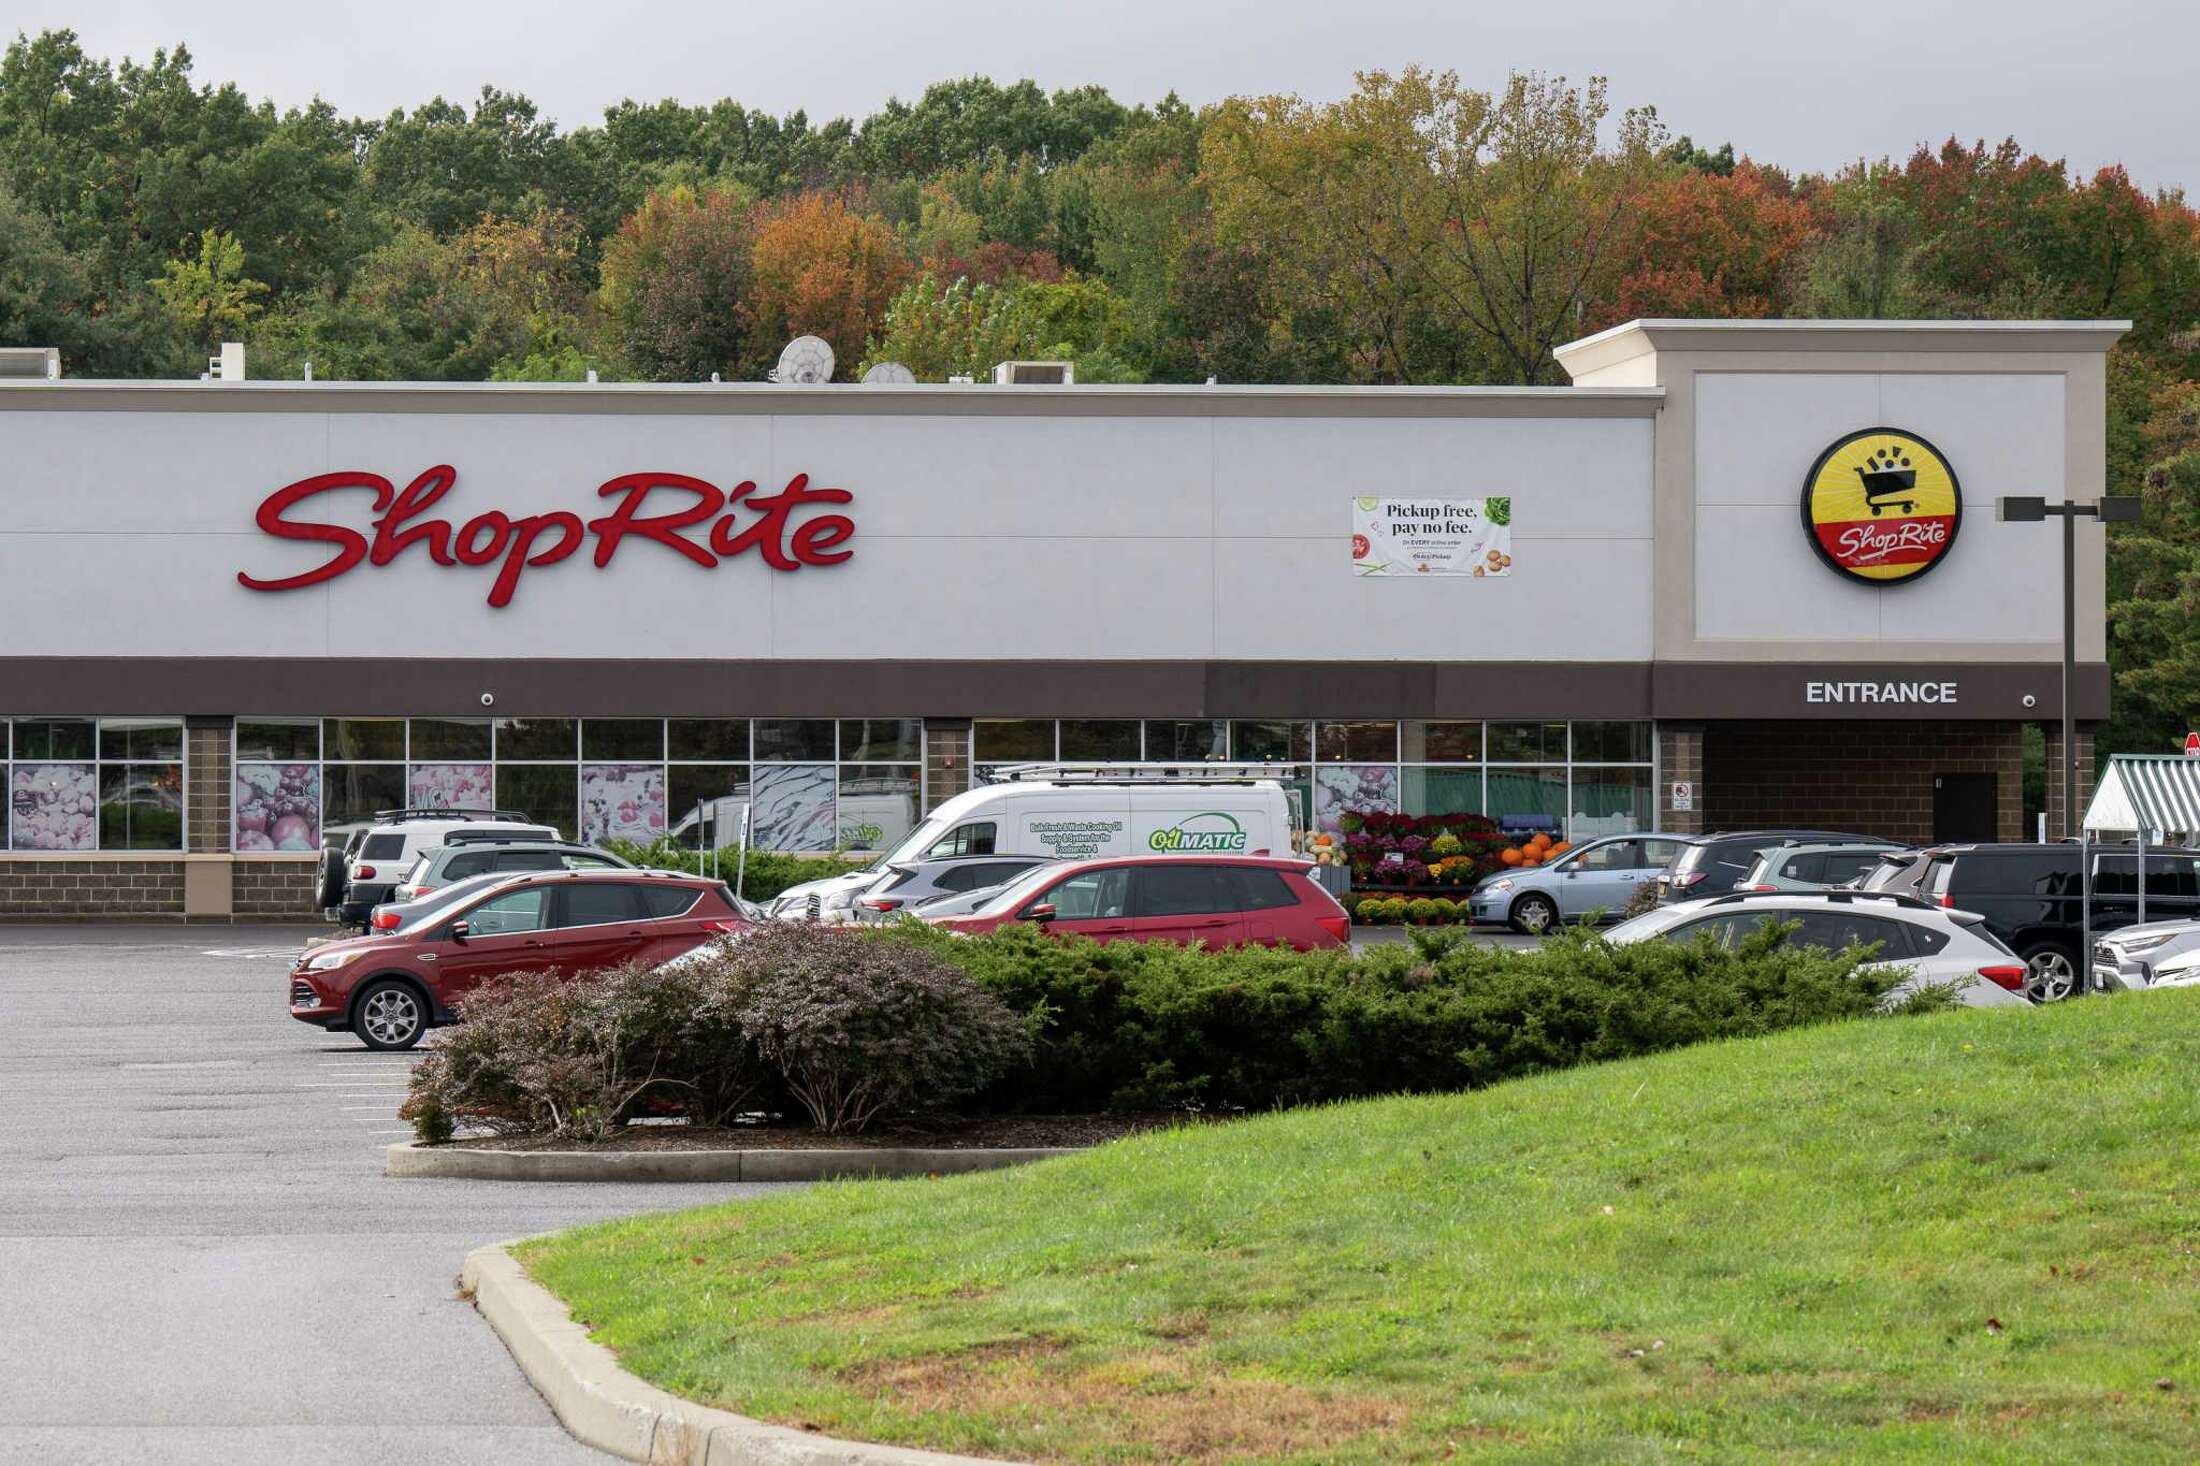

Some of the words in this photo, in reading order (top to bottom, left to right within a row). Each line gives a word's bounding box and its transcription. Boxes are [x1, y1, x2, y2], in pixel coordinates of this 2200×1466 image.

[1387, 504, 1440, 520] Pickup
[1443, 504, 1477, 519] free,
[237, 464, 855, 608] ShopRite
[1392, 523, 1419, 536] pay
[1423, 523, 1442, 534] no
[1445, 521, 1472, 534] fee.
[1837, 521, 1946, 558] ShopRite
[1807, 682, 1957, 703] ENTRANCE
[1087, 822, 1114, 833] Cooking
[1040, 833, 1061, 845] Supply
